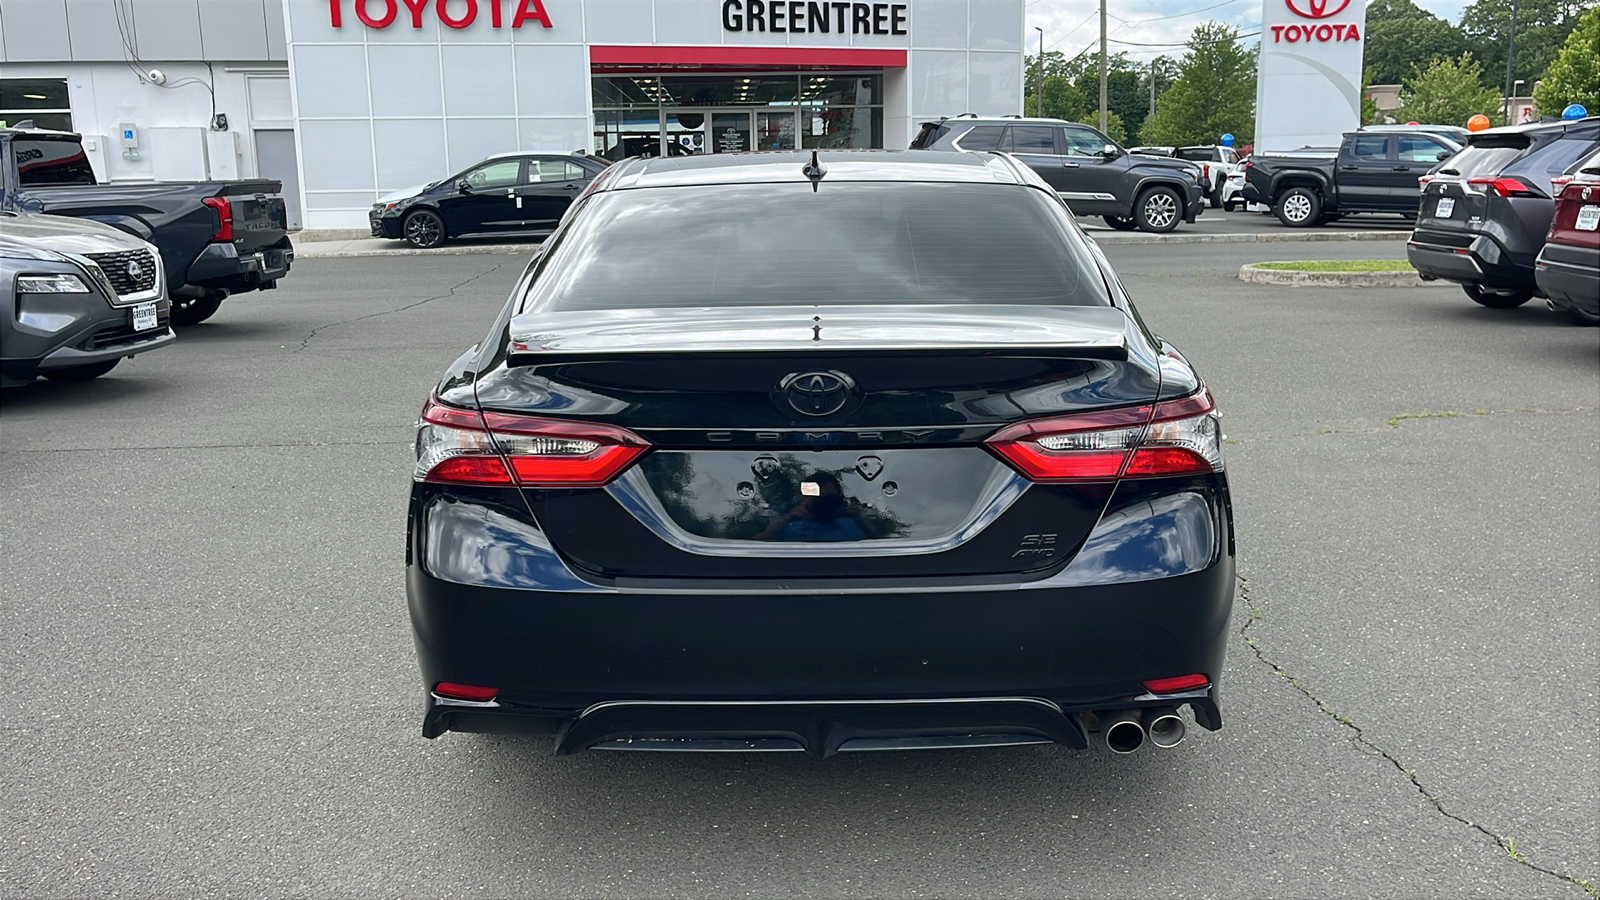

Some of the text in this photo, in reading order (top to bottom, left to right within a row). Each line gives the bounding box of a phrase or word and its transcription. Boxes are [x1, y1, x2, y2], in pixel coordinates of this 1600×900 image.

[329, 0, 553, 28] TOYOTA
[722, 0, 907, 35] GREENTREE
[1271, 24, 1360, 43] TOYOTA
[133, 307, 156, 319] GREENTREE
[706, 430, 935, 442] CAMRY
[1021, 533, 1058, 546] SE
[1011, 548, 1056, 558] AWD
